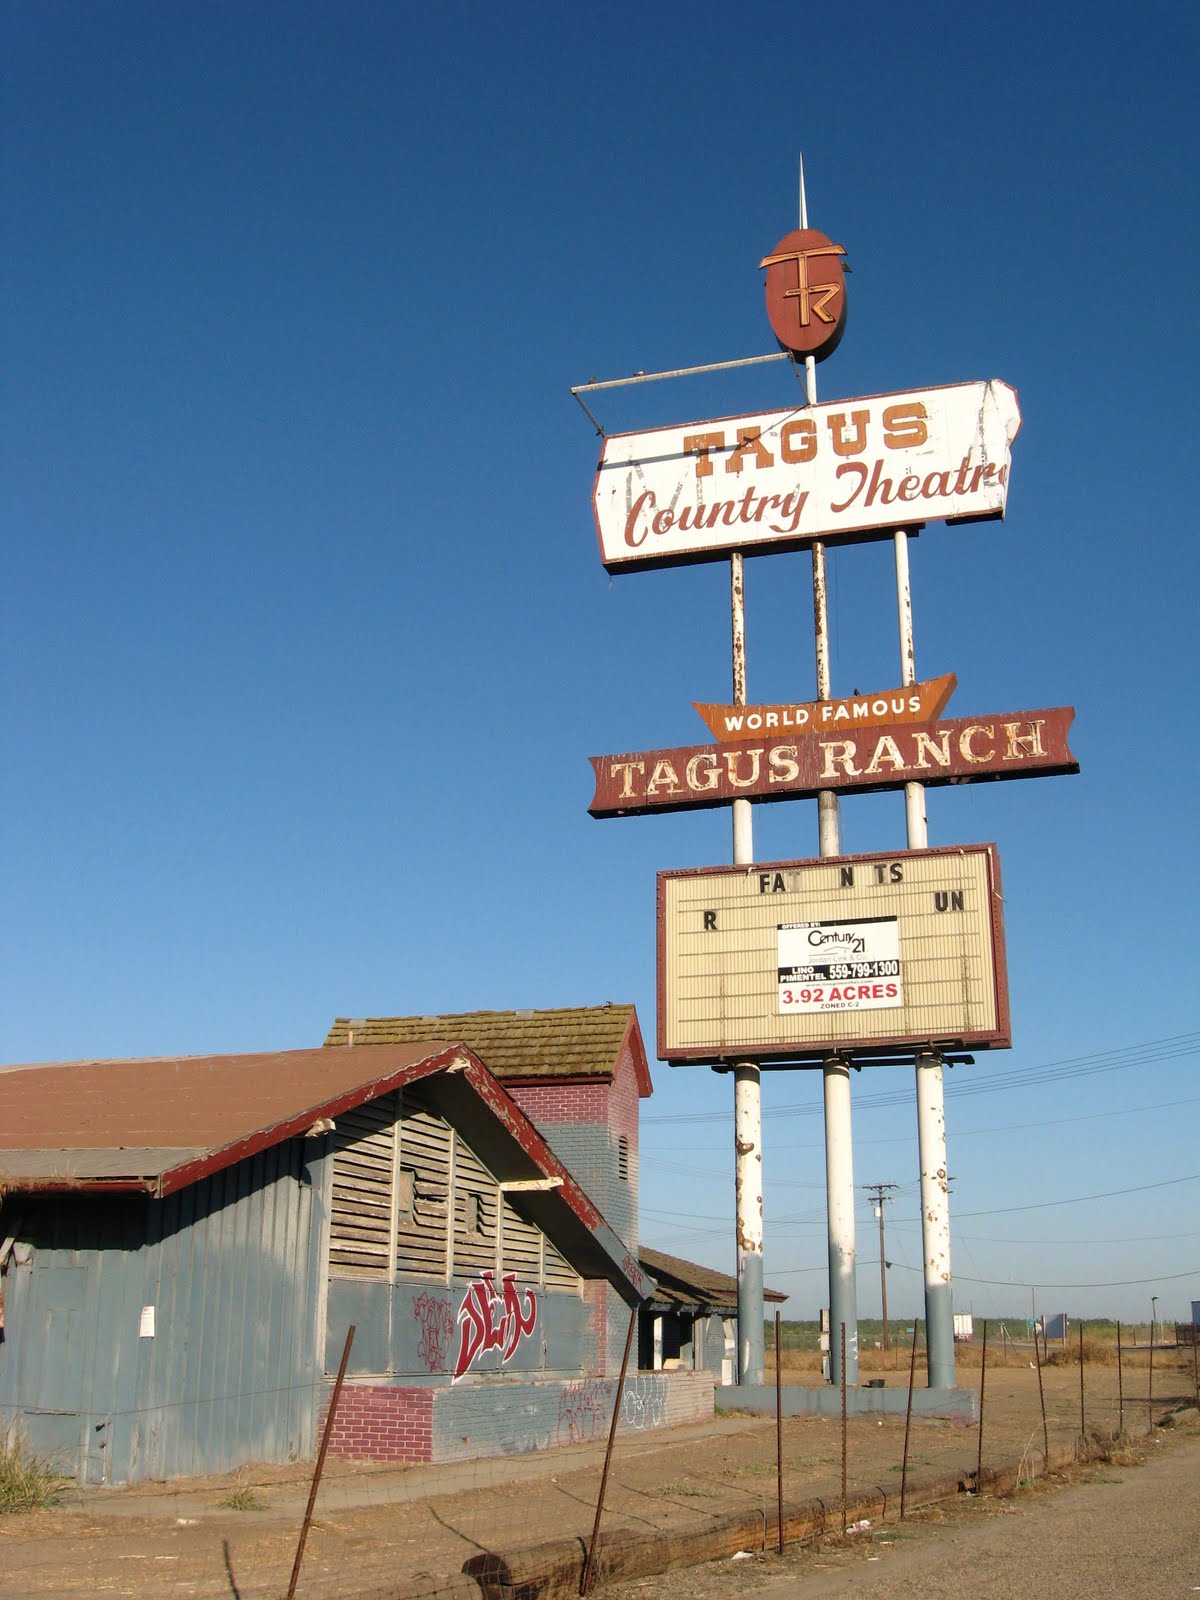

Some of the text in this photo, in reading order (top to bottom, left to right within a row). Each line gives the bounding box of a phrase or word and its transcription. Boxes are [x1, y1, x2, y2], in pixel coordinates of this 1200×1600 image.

[683, 401, 928, 478] TAGUS
[624, 485, 810, 548] Country
[724, 695, 921, 732] WORLD FAMOUS
[610, 719, 1048, 798] TAGUS RANCH
[704, 890, 965, 930] R UN
[807, 930, 865, 954] Century 21
[780, 972, 827, 983] PIMENTEL
[792, 960, 898, 980] LINO 559-799-1300
[782, 983, 898, 1004] 3.92 ACRES
